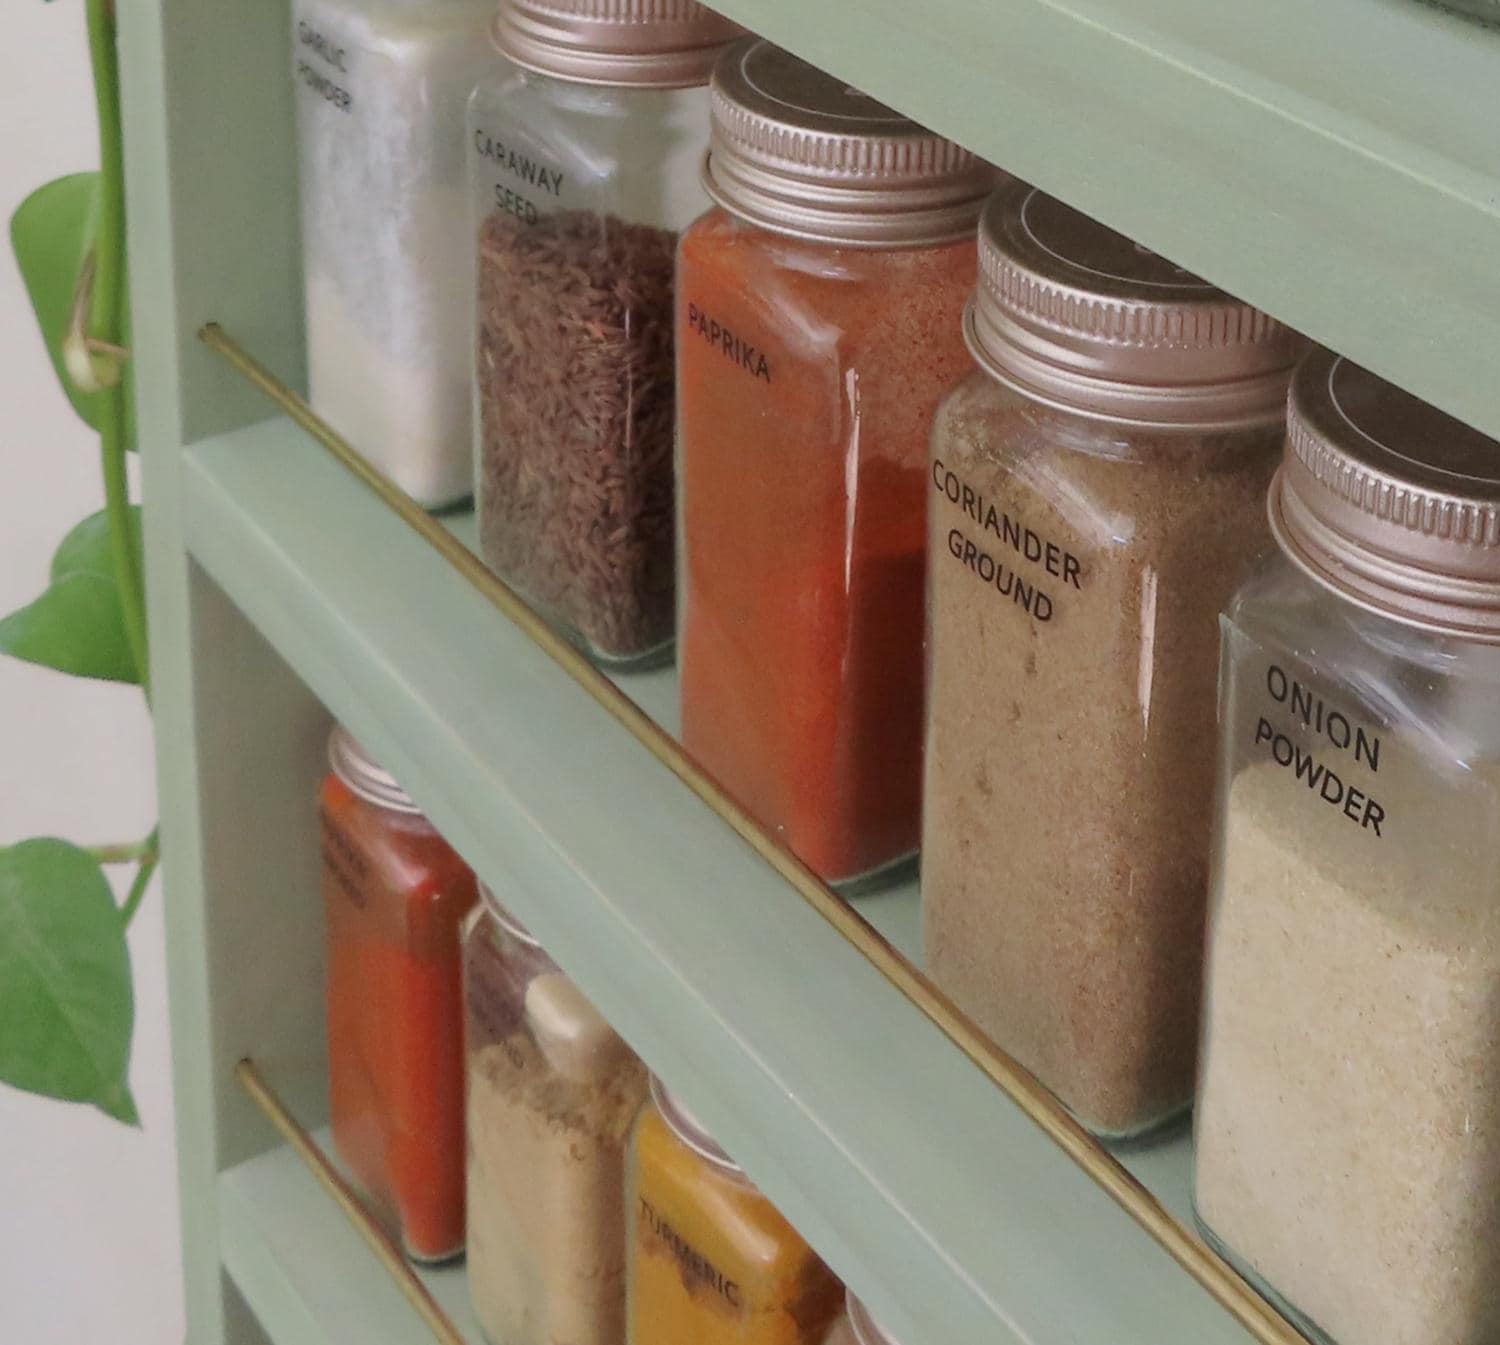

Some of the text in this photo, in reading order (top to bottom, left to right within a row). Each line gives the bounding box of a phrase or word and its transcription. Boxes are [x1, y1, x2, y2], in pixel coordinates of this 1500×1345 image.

[474, 128, 564, 197] CARAWAY
[495, 183, 538, 227] SEED
[688, 302, 772, 384] PAPRIKA
[933, 459, 1082, 590] CORIANDER
[948, 529, 1053, 622] GROUND
[1267, 665, 1380, 772] ONION
[1255, 717, 1386, 838] POWDER
